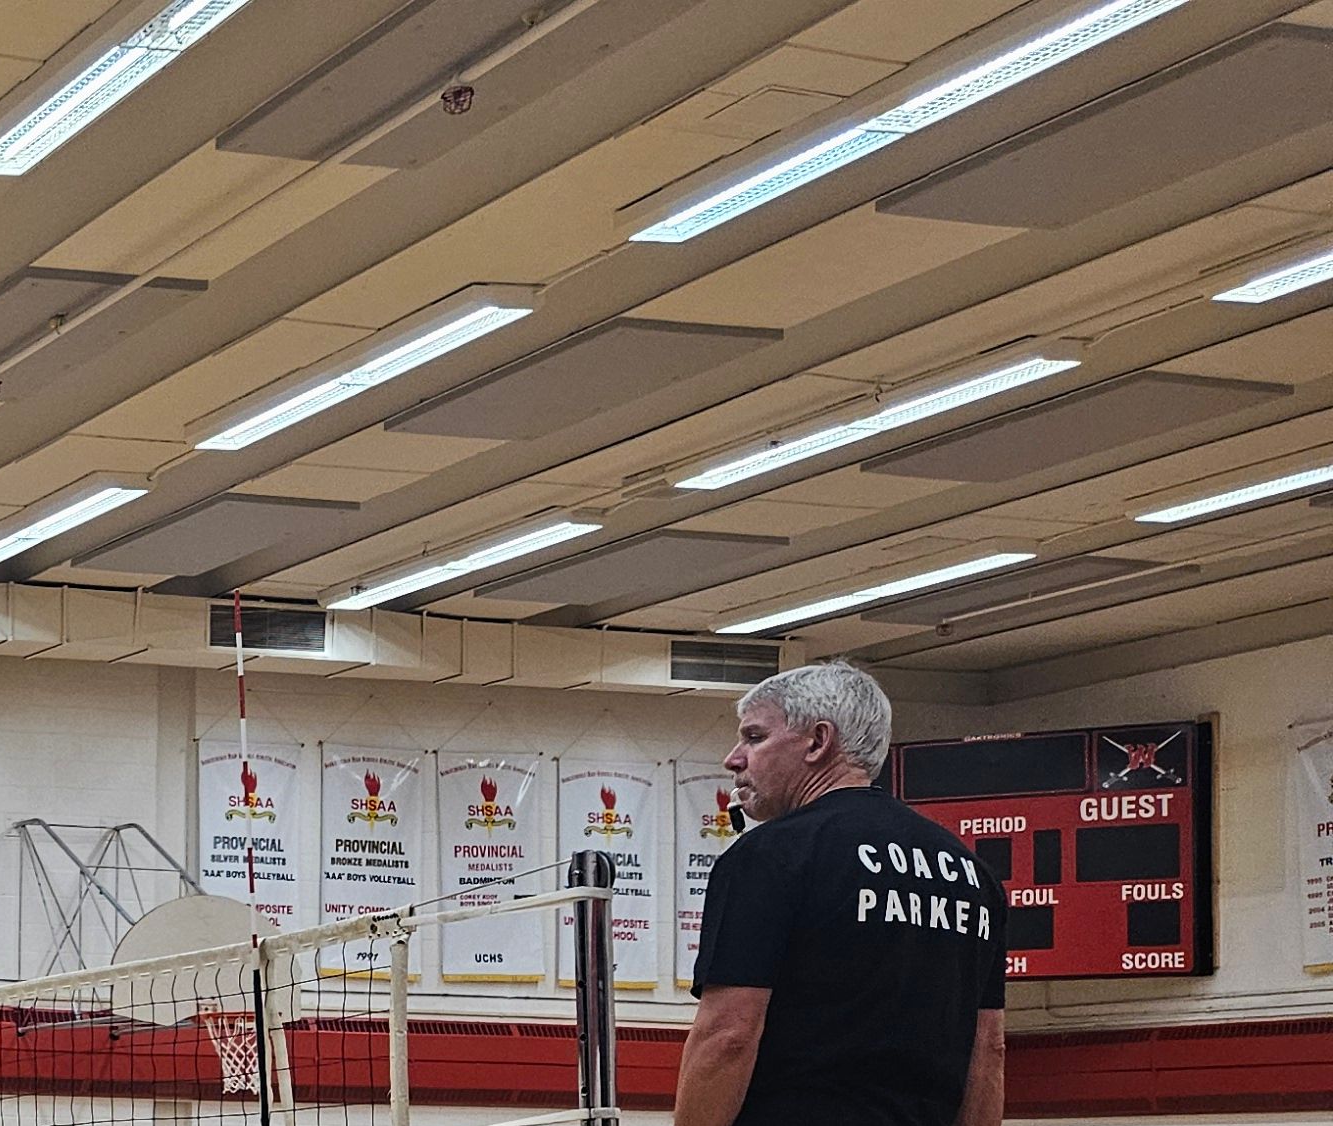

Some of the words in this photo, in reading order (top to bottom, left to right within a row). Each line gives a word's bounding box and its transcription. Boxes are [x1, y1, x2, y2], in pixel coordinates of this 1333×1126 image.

[351, 799, 397, 812] SHSAA
[467, 804, 513, 817] SHSAA
[1080, 793, 1174, 822] GUEST
[587, 812, 632, 825] SHSAA
[702, 814, 732, 827] SHS
[960, 817, 1026, 836] PERIOD
[213, 836, 284, 852] PROVNCIAL
[335, 839, 405, 855] PROVINCIAL
[454, 845, 524, 859] PROVINCIAL
[211, 854, 239, 863] SILVER
[243, 855, 286, 866] MDALISTS
[330, 857, 362, 867] BRONZE
[365, 858, 409, 869] MEDALISTS
[857, 842, 980, 890] COACH
[468, 863, 514, 872] MEDALISTS
[226, 870, 246, 879] BOYS
[252, 871, 296, 882] OLLEYBALL
[347, 873, 367, 882] BOYS
[369, 874, 416, 886] VOLLEYBALL
[616, 871, 643, 880] ALISTS
[613, 887, 652, 897] OLLEYBALL
[1010, 888, 1059, 906] FOUL
[1121, 882, 1183, 901] FOULS
[255, 903, 293, 914] POSITE
[325, 903, 354, 915] UNITY
[857, 888, 990, 941] PARKER
[613, 931, 638, 941] HOOL
[474, 953, 503, 963] UCHS
[1121, 952, 1184, 970] SCORE
